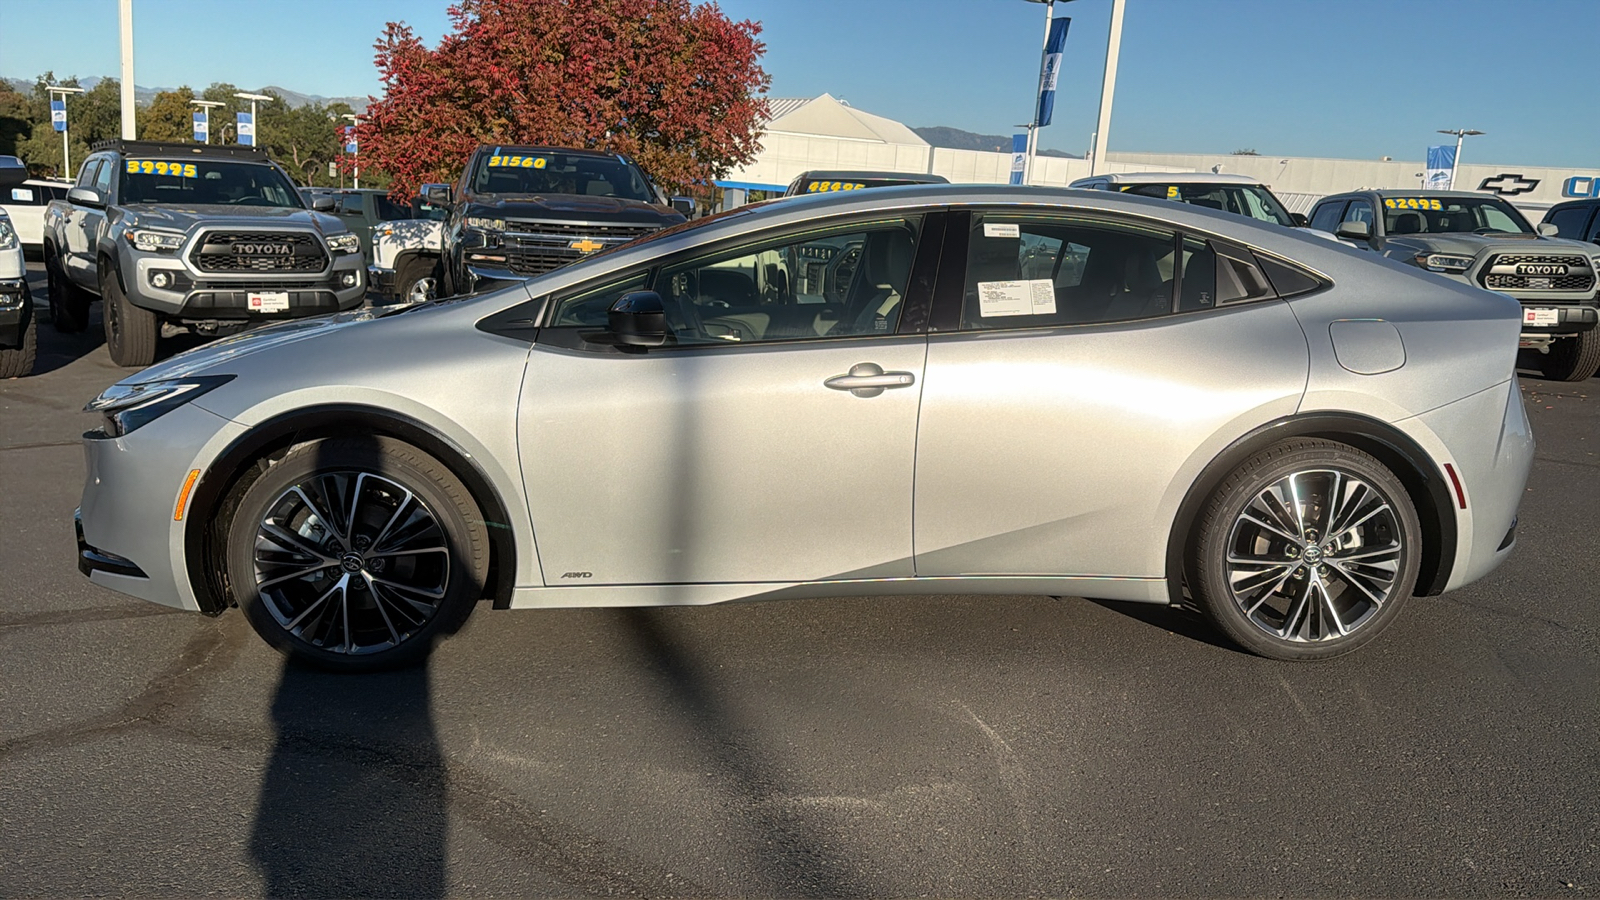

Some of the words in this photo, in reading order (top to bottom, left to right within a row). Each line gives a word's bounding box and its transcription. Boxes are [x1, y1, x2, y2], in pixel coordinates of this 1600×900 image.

[488, 156, 546, 168] 31560
[127, 161, 196, 177] 39995
[1385, 199, 1441, 210] 42495
[236, 244, 290, 254] TOYOTA
[1520, 265, 1565, 275] TOYOTA
[560, 571, 593, 579] AWD
